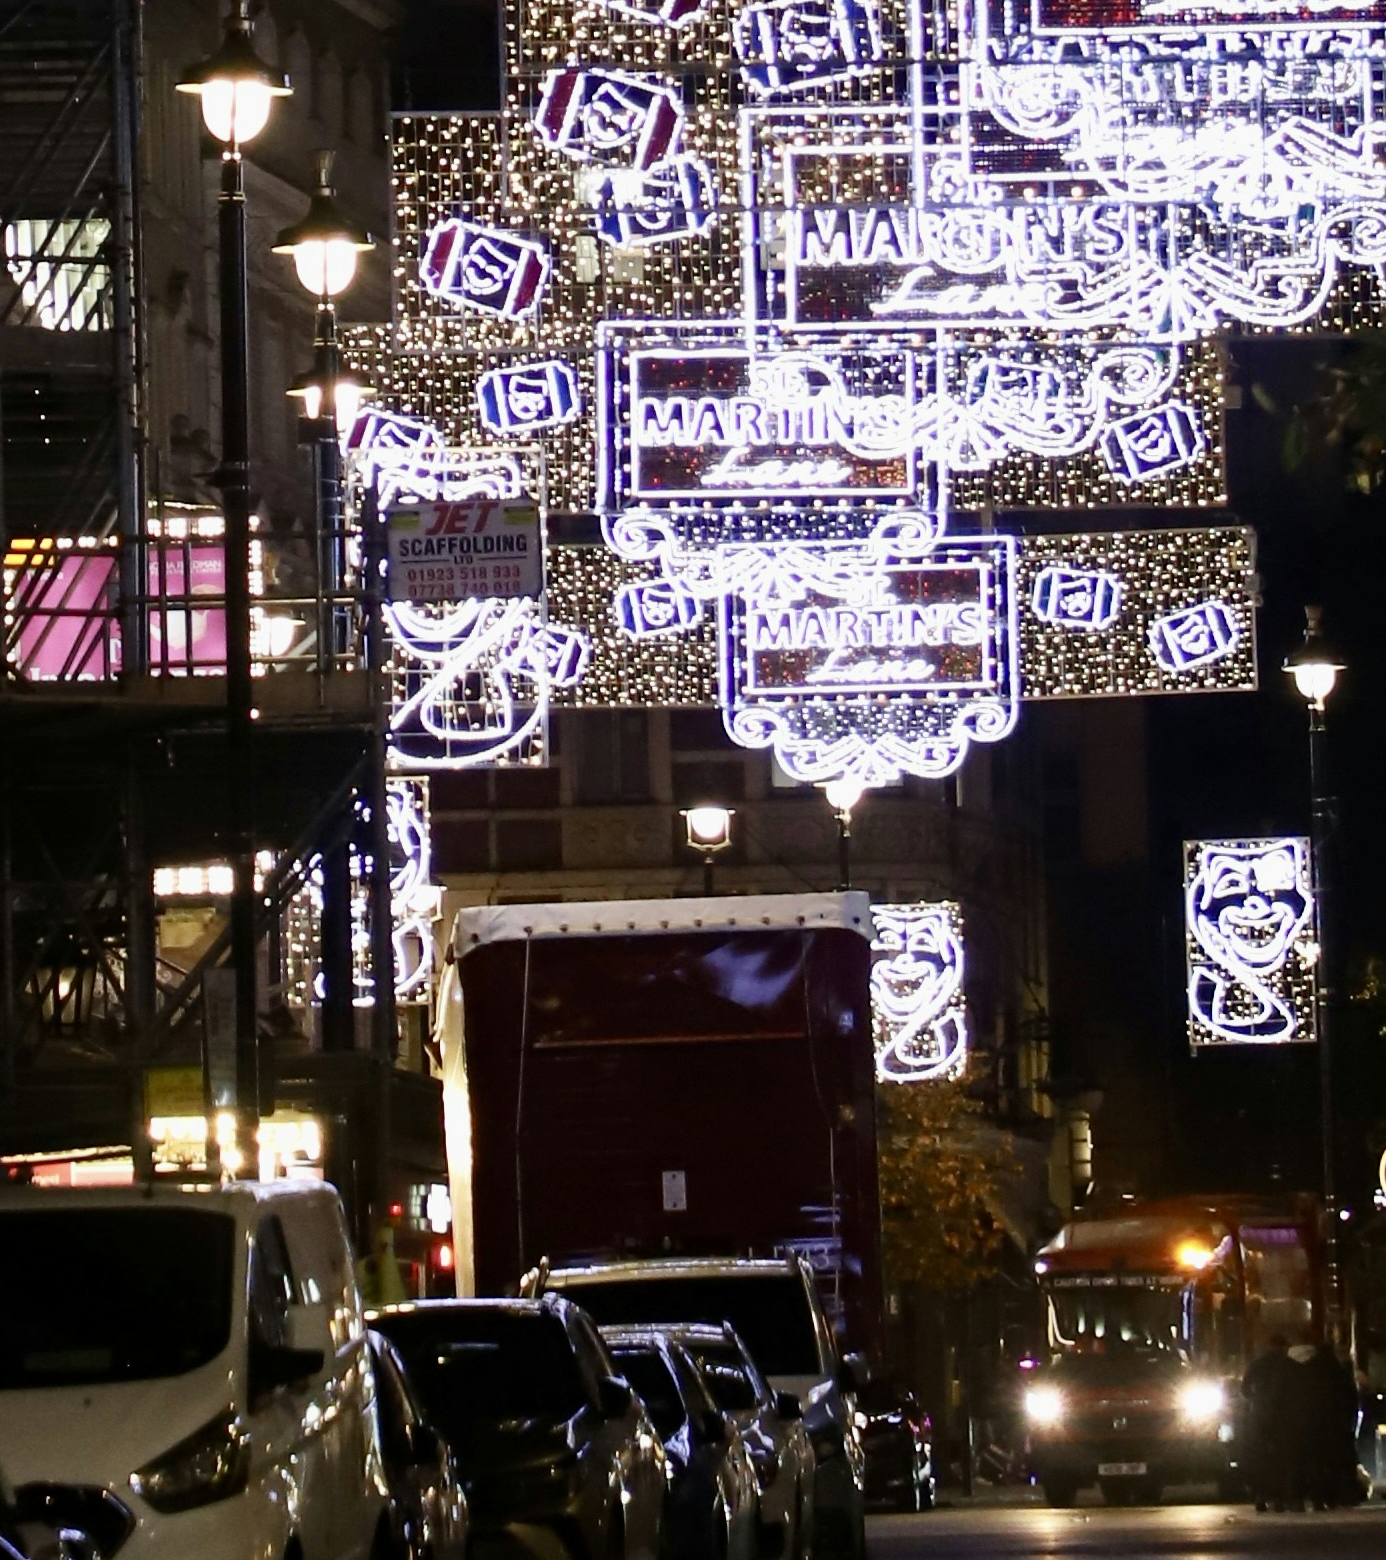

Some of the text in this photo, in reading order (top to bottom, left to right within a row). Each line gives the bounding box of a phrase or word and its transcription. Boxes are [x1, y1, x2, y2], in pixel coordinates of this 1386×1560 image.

[637, 396, 909, 447] MARTIN
[700, 446, 854, 485] Lane
[424, 500, 500, 536] JET
[399, 533, 528, 558] SCAFFOLDING
[407, 566, 455, 582] 01923
[460, 565, 488, 581] 518
[751, 602, 983, 650] MARTIN'S
[805, 647, 936, 682] Lane
